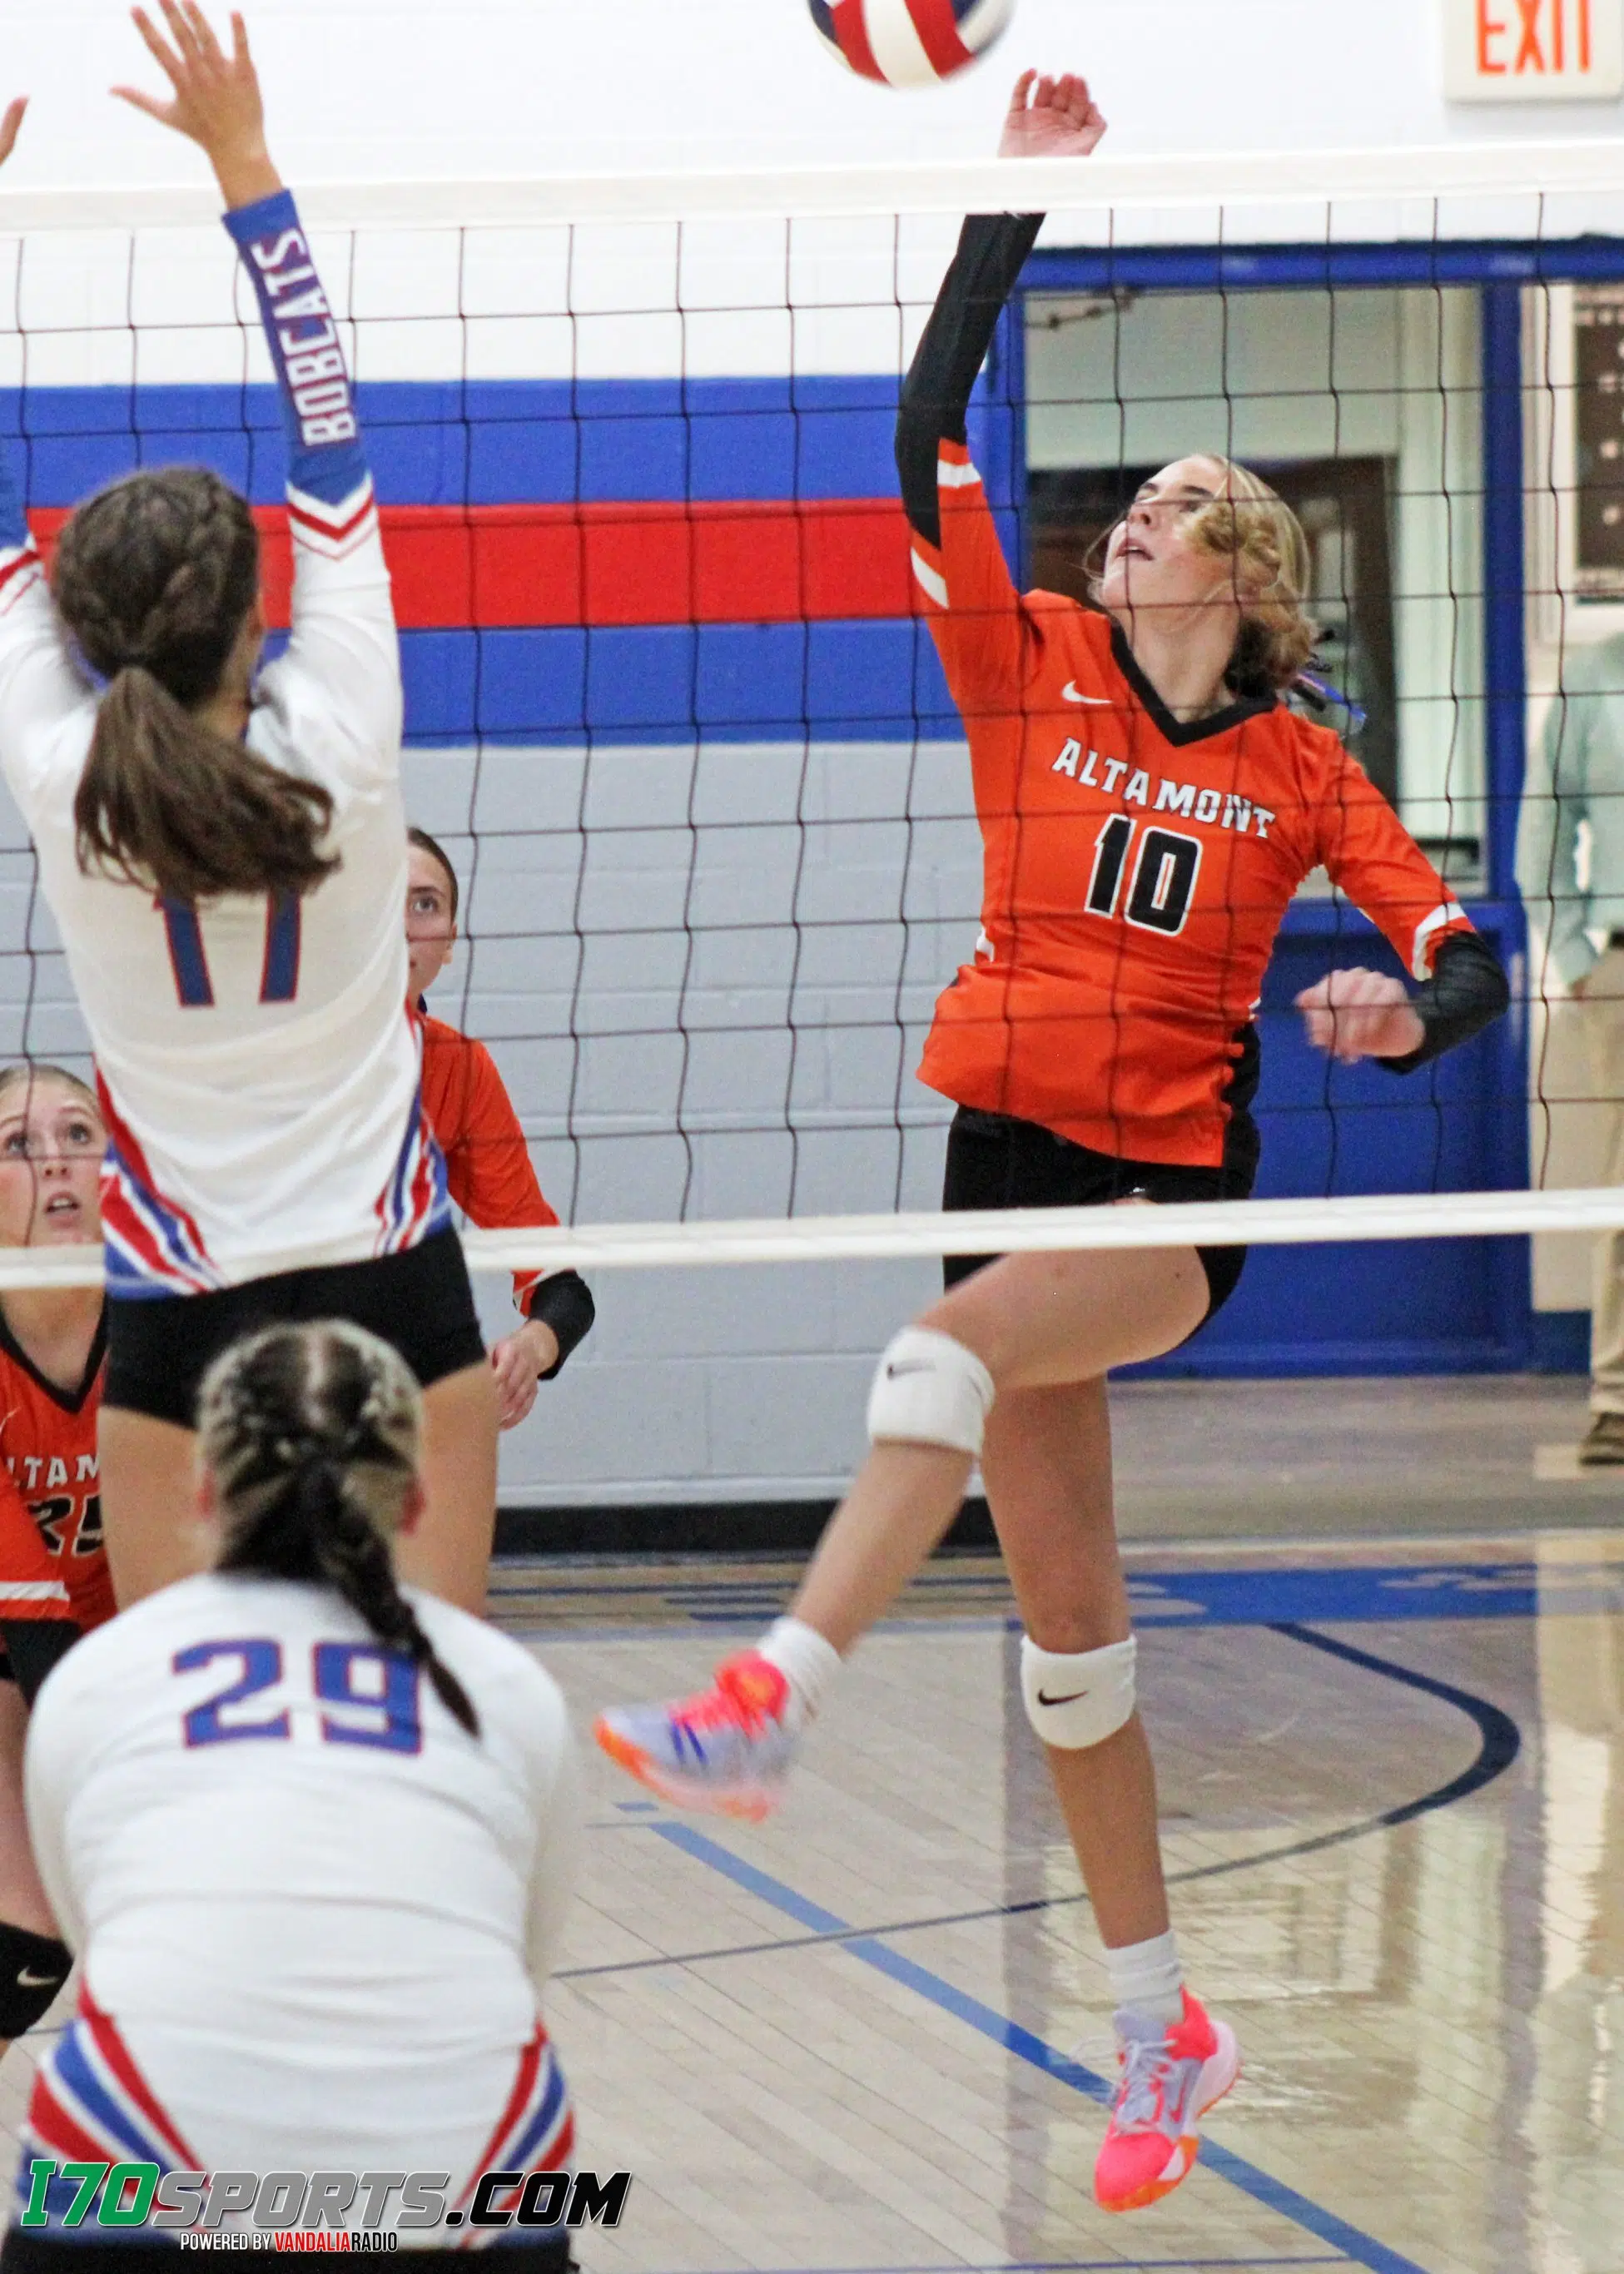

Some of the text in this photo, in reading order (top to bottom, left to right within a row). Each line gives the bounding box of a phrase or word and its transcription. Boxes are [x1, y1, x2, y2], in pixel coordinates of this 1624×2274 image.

[251, 228, 356, 447] BOBCATS
[1051, 737, 1275, 839] ALTAMONT
[1084, 812, 1204, 937] 10
[171, 1638, 422, 1758] 29
